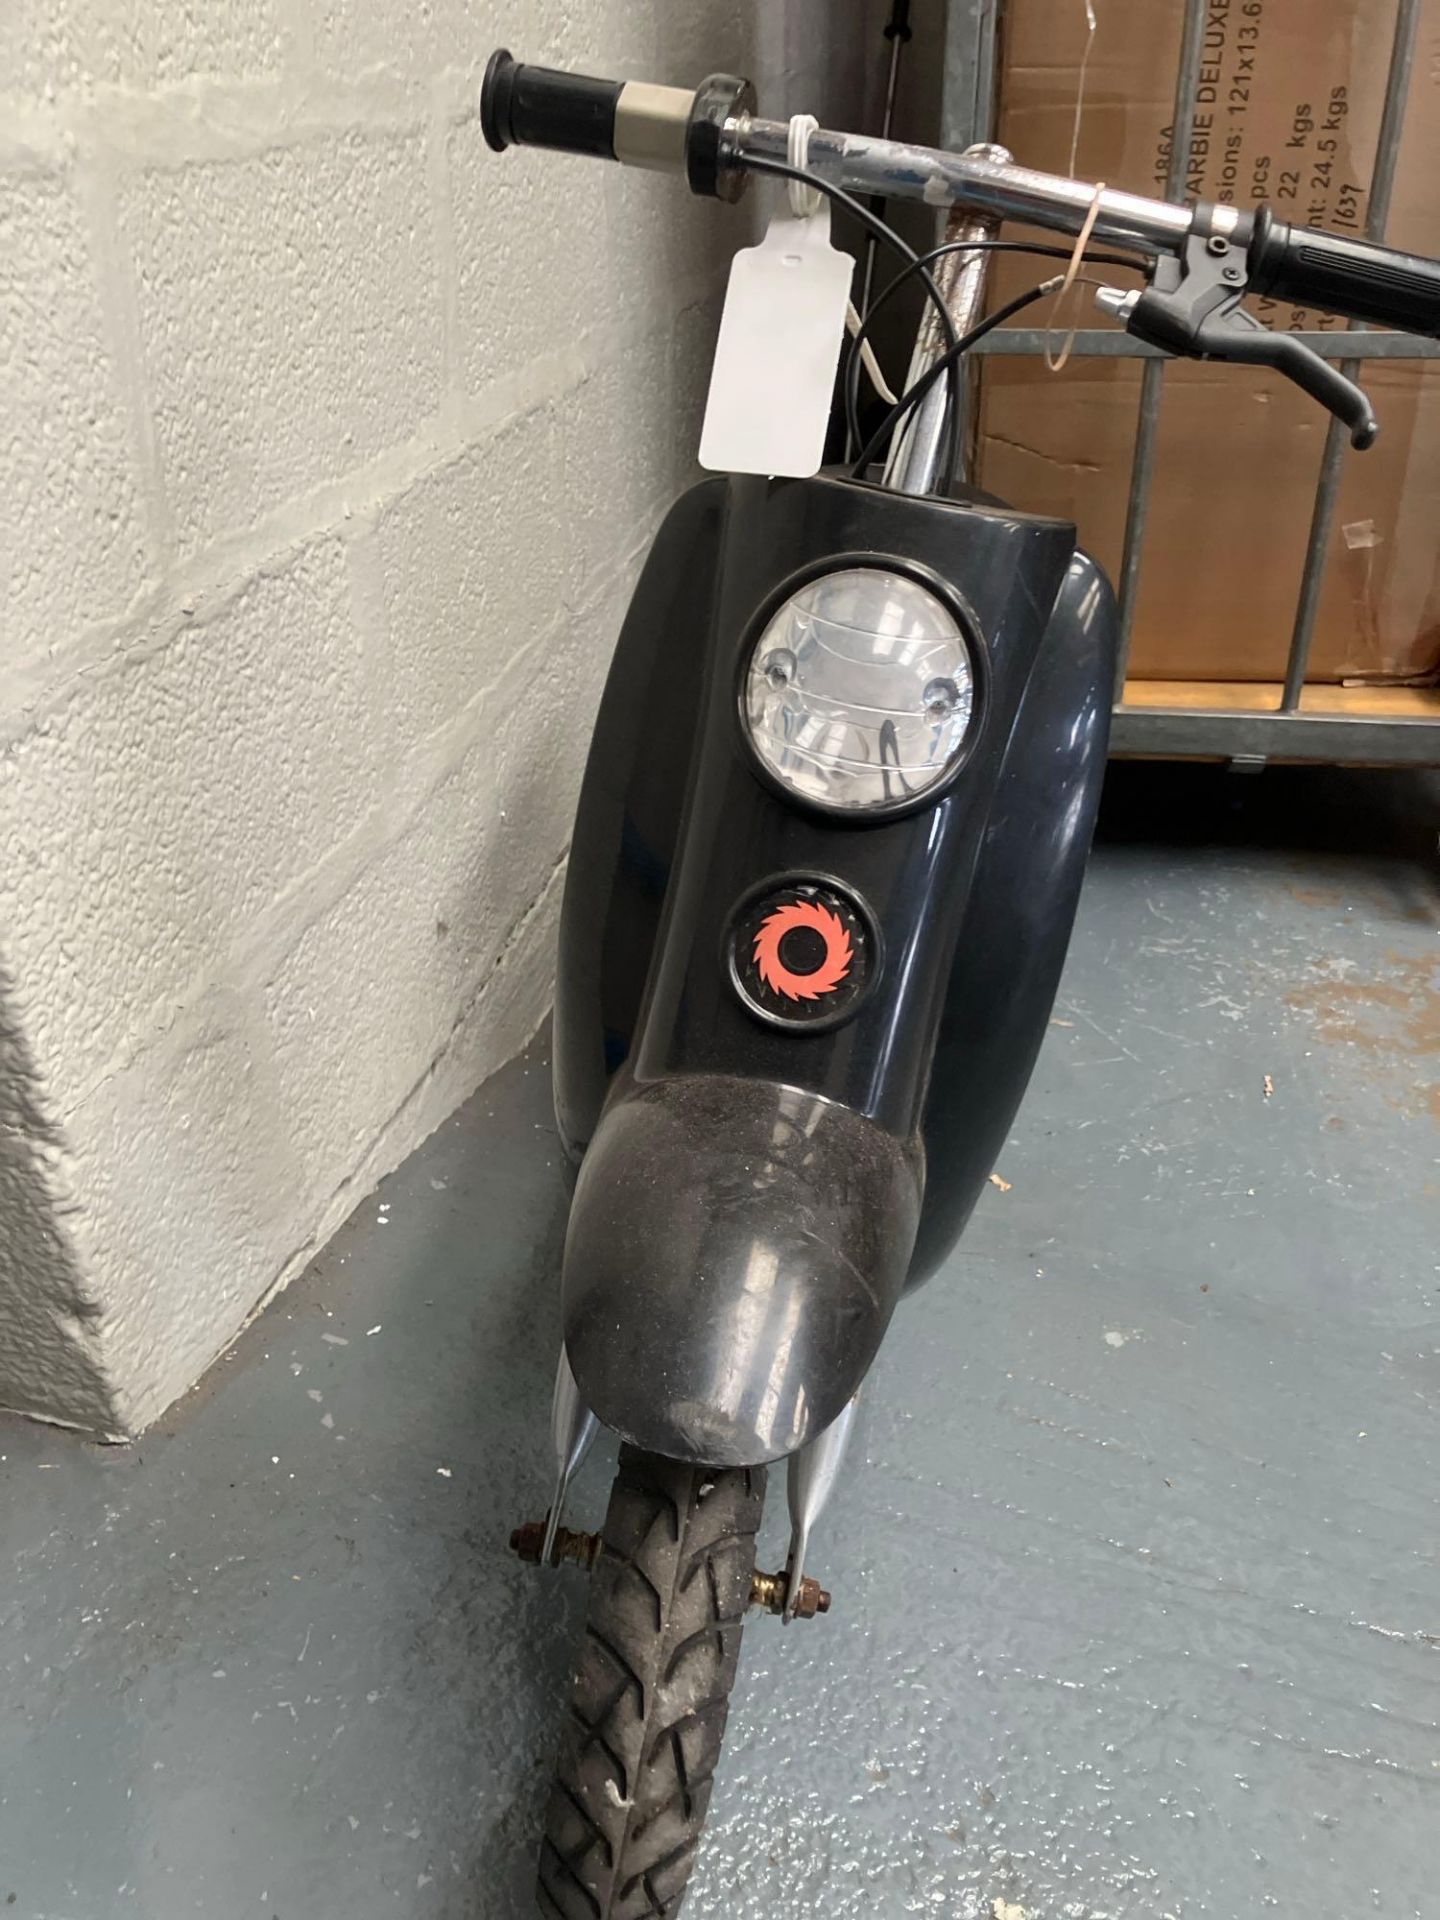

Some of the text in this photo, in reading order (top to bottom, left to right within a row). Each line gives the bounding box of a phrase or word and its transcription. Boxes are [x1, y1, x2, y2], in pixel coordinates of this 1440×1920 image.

[1196, 0, 1231, 104] DELUXE
[1215, 0, 1263, 202] sions: 121x13.6
[1321, 85, 1349, 130] kgs
[1250, 156, 1271, 199] pcs
[1277, 103, 1314, 199] 22 kgs
[1310, 140, 1338, 189] 24.5
